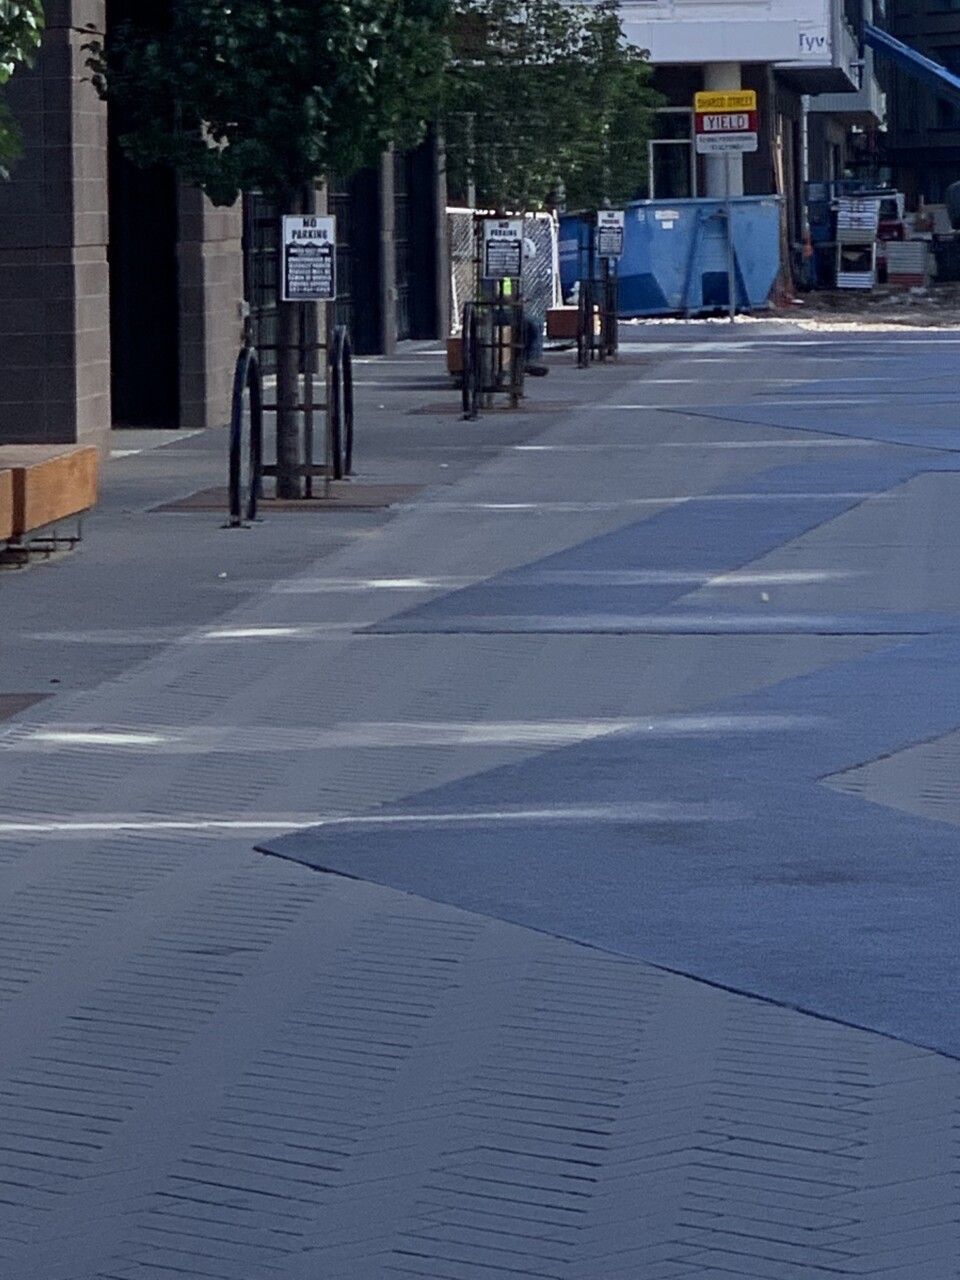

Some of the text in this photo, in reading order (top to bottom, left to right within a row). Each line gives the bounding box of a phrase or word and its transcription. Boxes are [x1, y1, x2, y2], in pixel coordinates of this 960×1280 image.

[707, 115, 745, 129] YIELD
[303, 217, 317, 228] NO
[291, 229, 328, 240] PARKING
